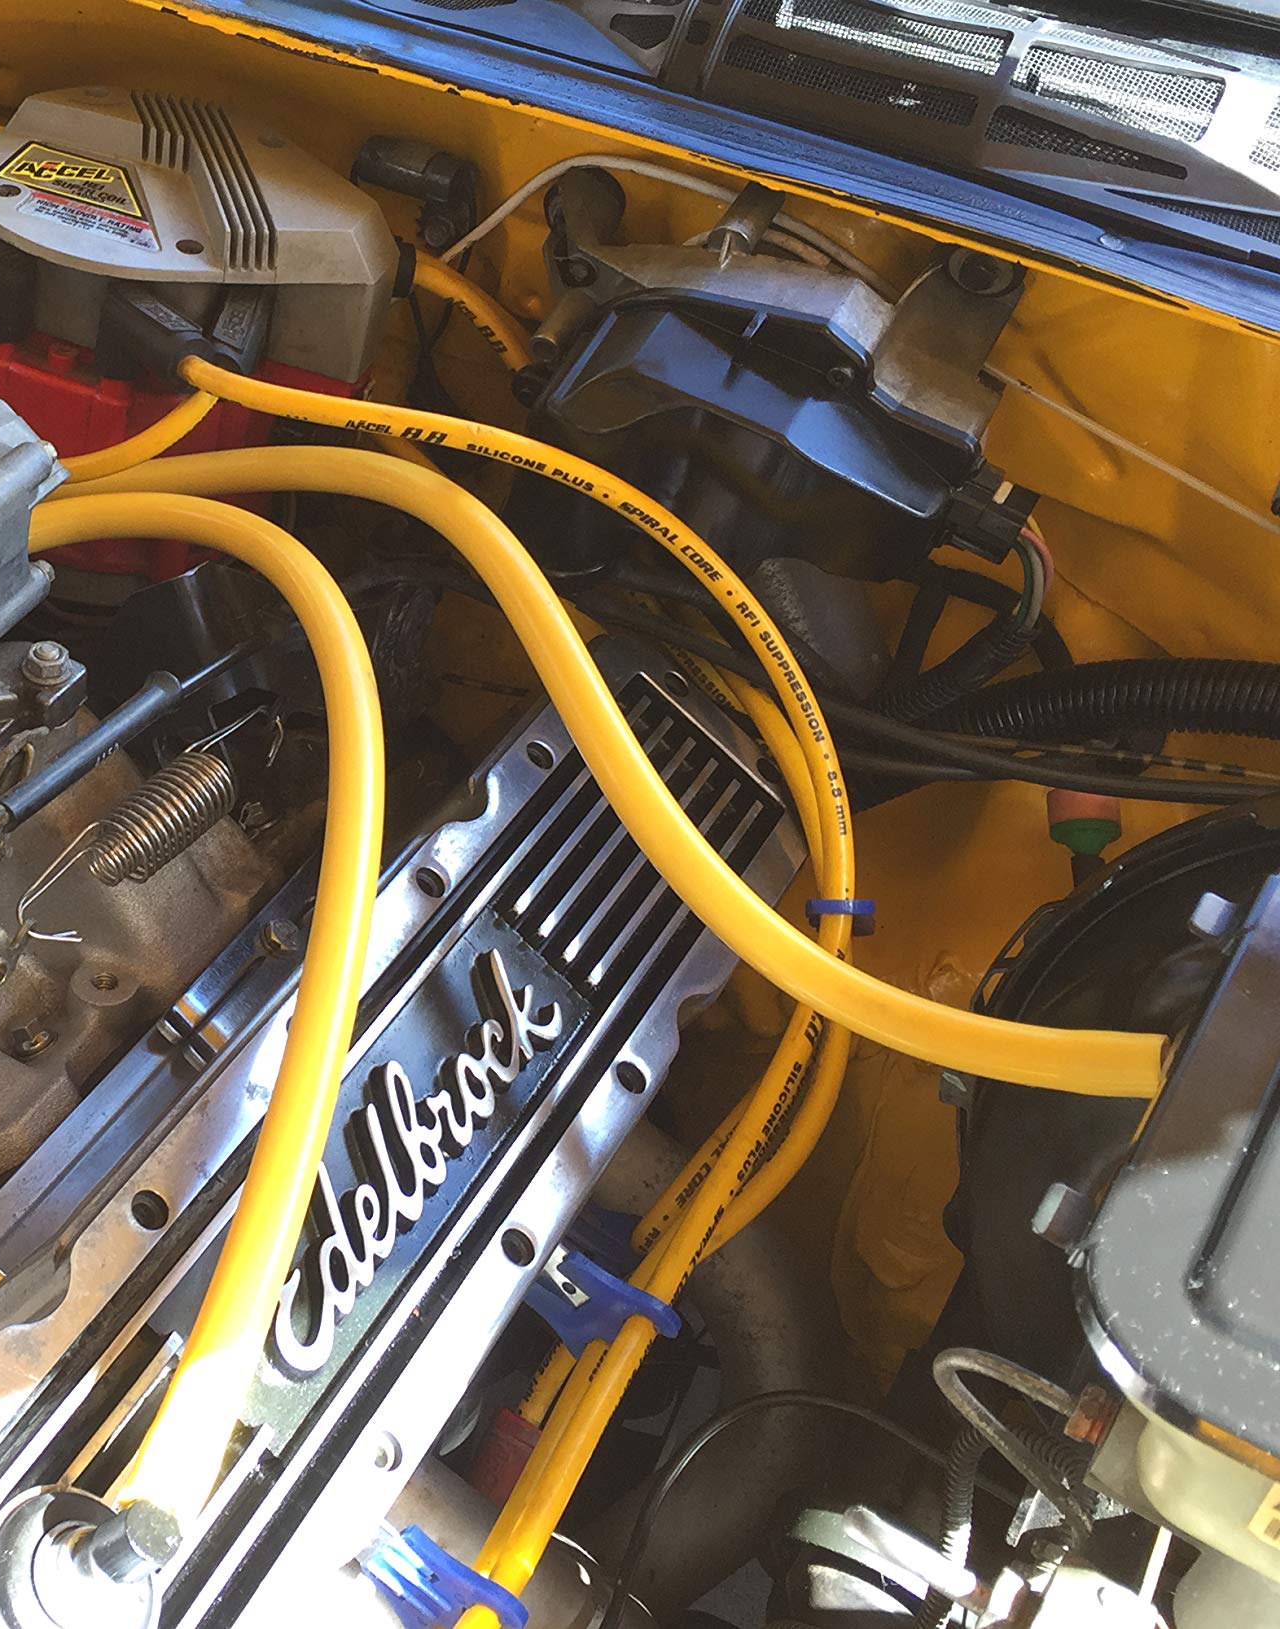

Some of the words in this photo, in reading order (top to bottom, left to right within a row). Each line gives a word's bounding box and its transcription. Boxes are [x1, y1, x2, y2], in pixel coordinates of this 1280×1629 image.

[12, 160, 115, 182] ACCEL
[51, 180, 98, 200] SUPER
[98, 190, 128, 207] COIL
[106, 217, 143, 234] RATING
[345, 419, 393, 435] ACCEL
[400, 426, 448, 445] 8.8
[465, 443, 546, 473] SILICONE
[550, 467, 594, 492] PLUS
[618, 501, 679, 546] SPIRAL
[680, 545, 724, 583] CORE
[736, 600, 760, 628] RFI
[759, 631, 825, 744] SUPPRESSION
[827, 770, 843, 799] 8.8
[835, 804, 847, 837] mm
[761, 1061, 803, 1136] SILICONE
[274, 948, 564, 1372] Edelbrock
[736, 1139, 763, 1183] PLUS
[674, 1162, 713, 1208] CORE
